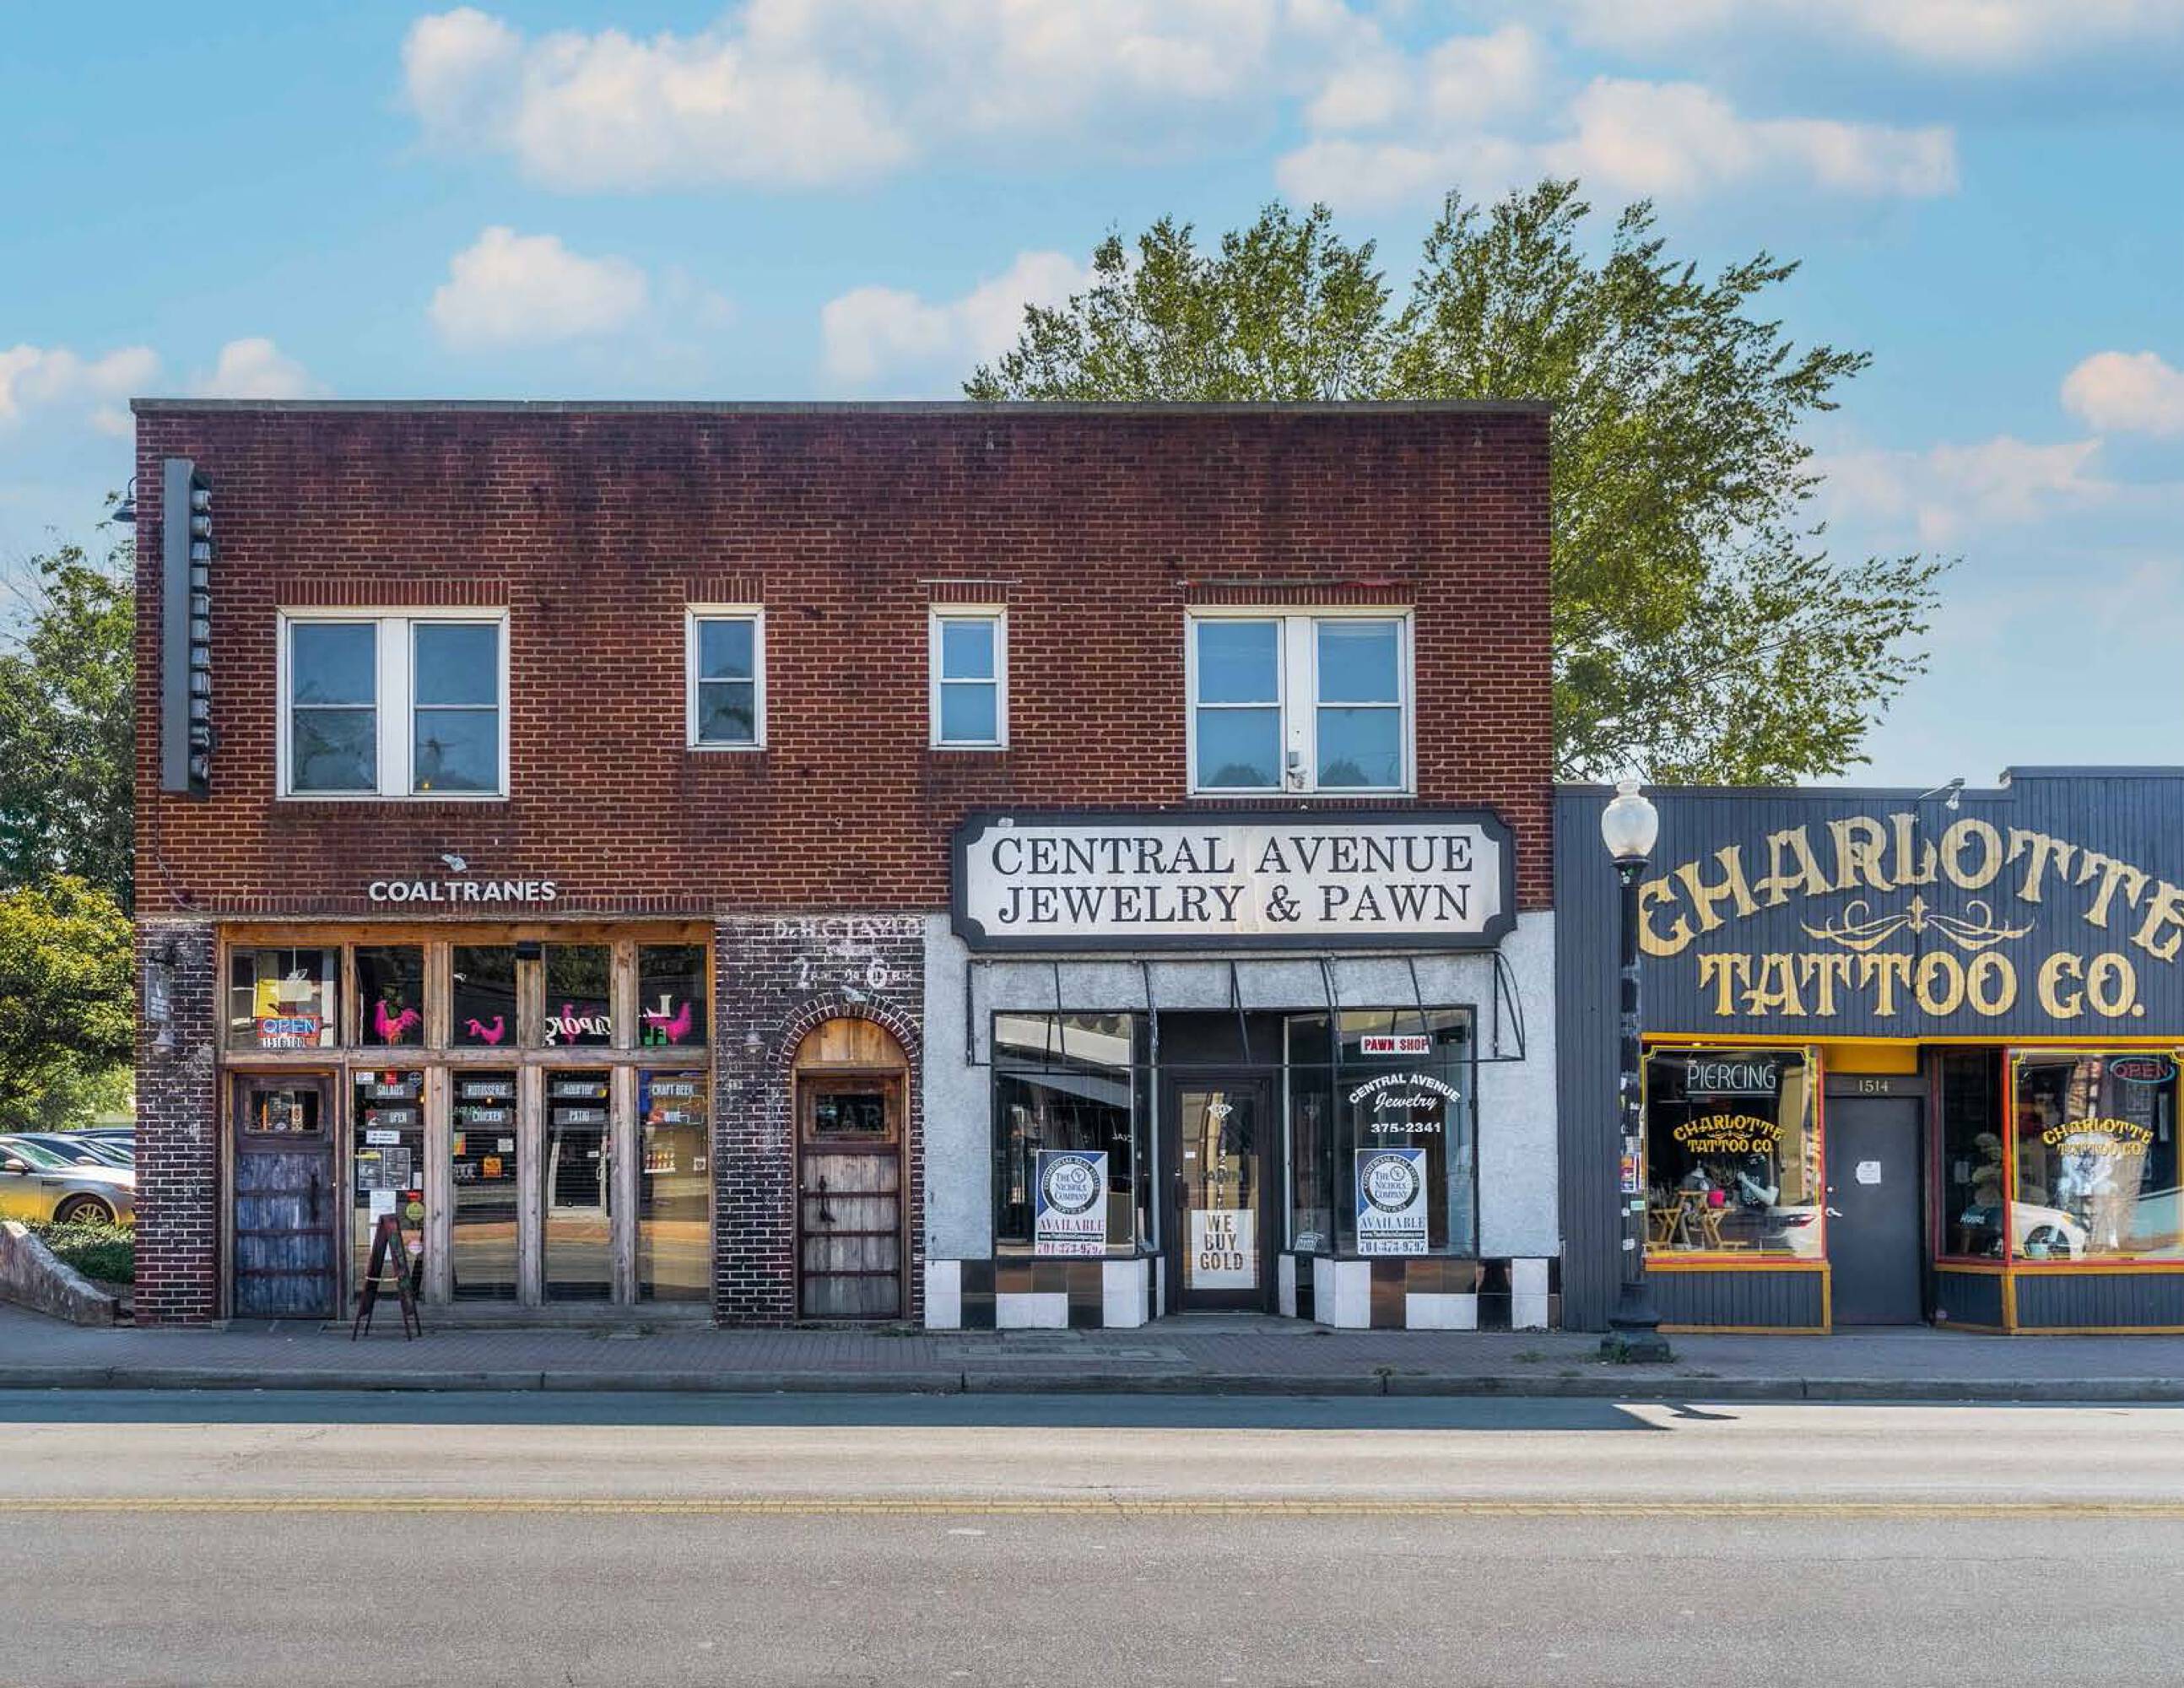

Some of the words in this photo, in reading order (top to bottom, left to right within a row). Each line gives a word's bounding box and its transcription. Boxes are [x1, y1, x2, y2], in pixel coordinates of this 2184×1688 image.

[992, 836, 1235, 875] CENTRAL
[1255, 835, 1473, 874] AVENUE
[369, 881, 557, 901] COALTRANES
[1638, 814, 2184, 962] CHARLOTTE
[999, 885, 1245, 922] JEWELRY
[1266, 884, 1301, 922] &
[1318, 885, 1471, 921] PAWN
[1697, 951, 2018, 1017] TATTOO
[2037, 950, 2145, 1019] CO.
[262, 1019, 316, 1034] OPEN
[1364, 1038, 1395, 1051] PAWN
[1399, 1038, 1427, 1051] SHOP
[1687, 1063, 1776, 1089] PIERCING
[2115, 1063, 2160, 1079] OPEN
[1349, 1074, 1407, 1104] CENTRAL
[1410, 1074, 1461, 1102] AVENUE
[1859, 1079, 1889, 1093] 1514
[1373, 1092, 1438, 1113] Jewelry
[1370, 1122, 1441, 1133] 375-2341
[1673, 1114, 1785, 1141] CHARLOTTE
[2043, 1117, 2154, 1144] CHARLOTTE
[1688, 1139, 1749, 1153] TATTOO
[1038, 1219, 1104, 1231] AVAILABLE
[1207, 1215, 1233, 1231] WE
[1360, 1216, 1425, 1230] AVAILABLE
[1205, 1233, 1236, 1250] BUY
[1200, 1252, 1243, 1270] GOLD
